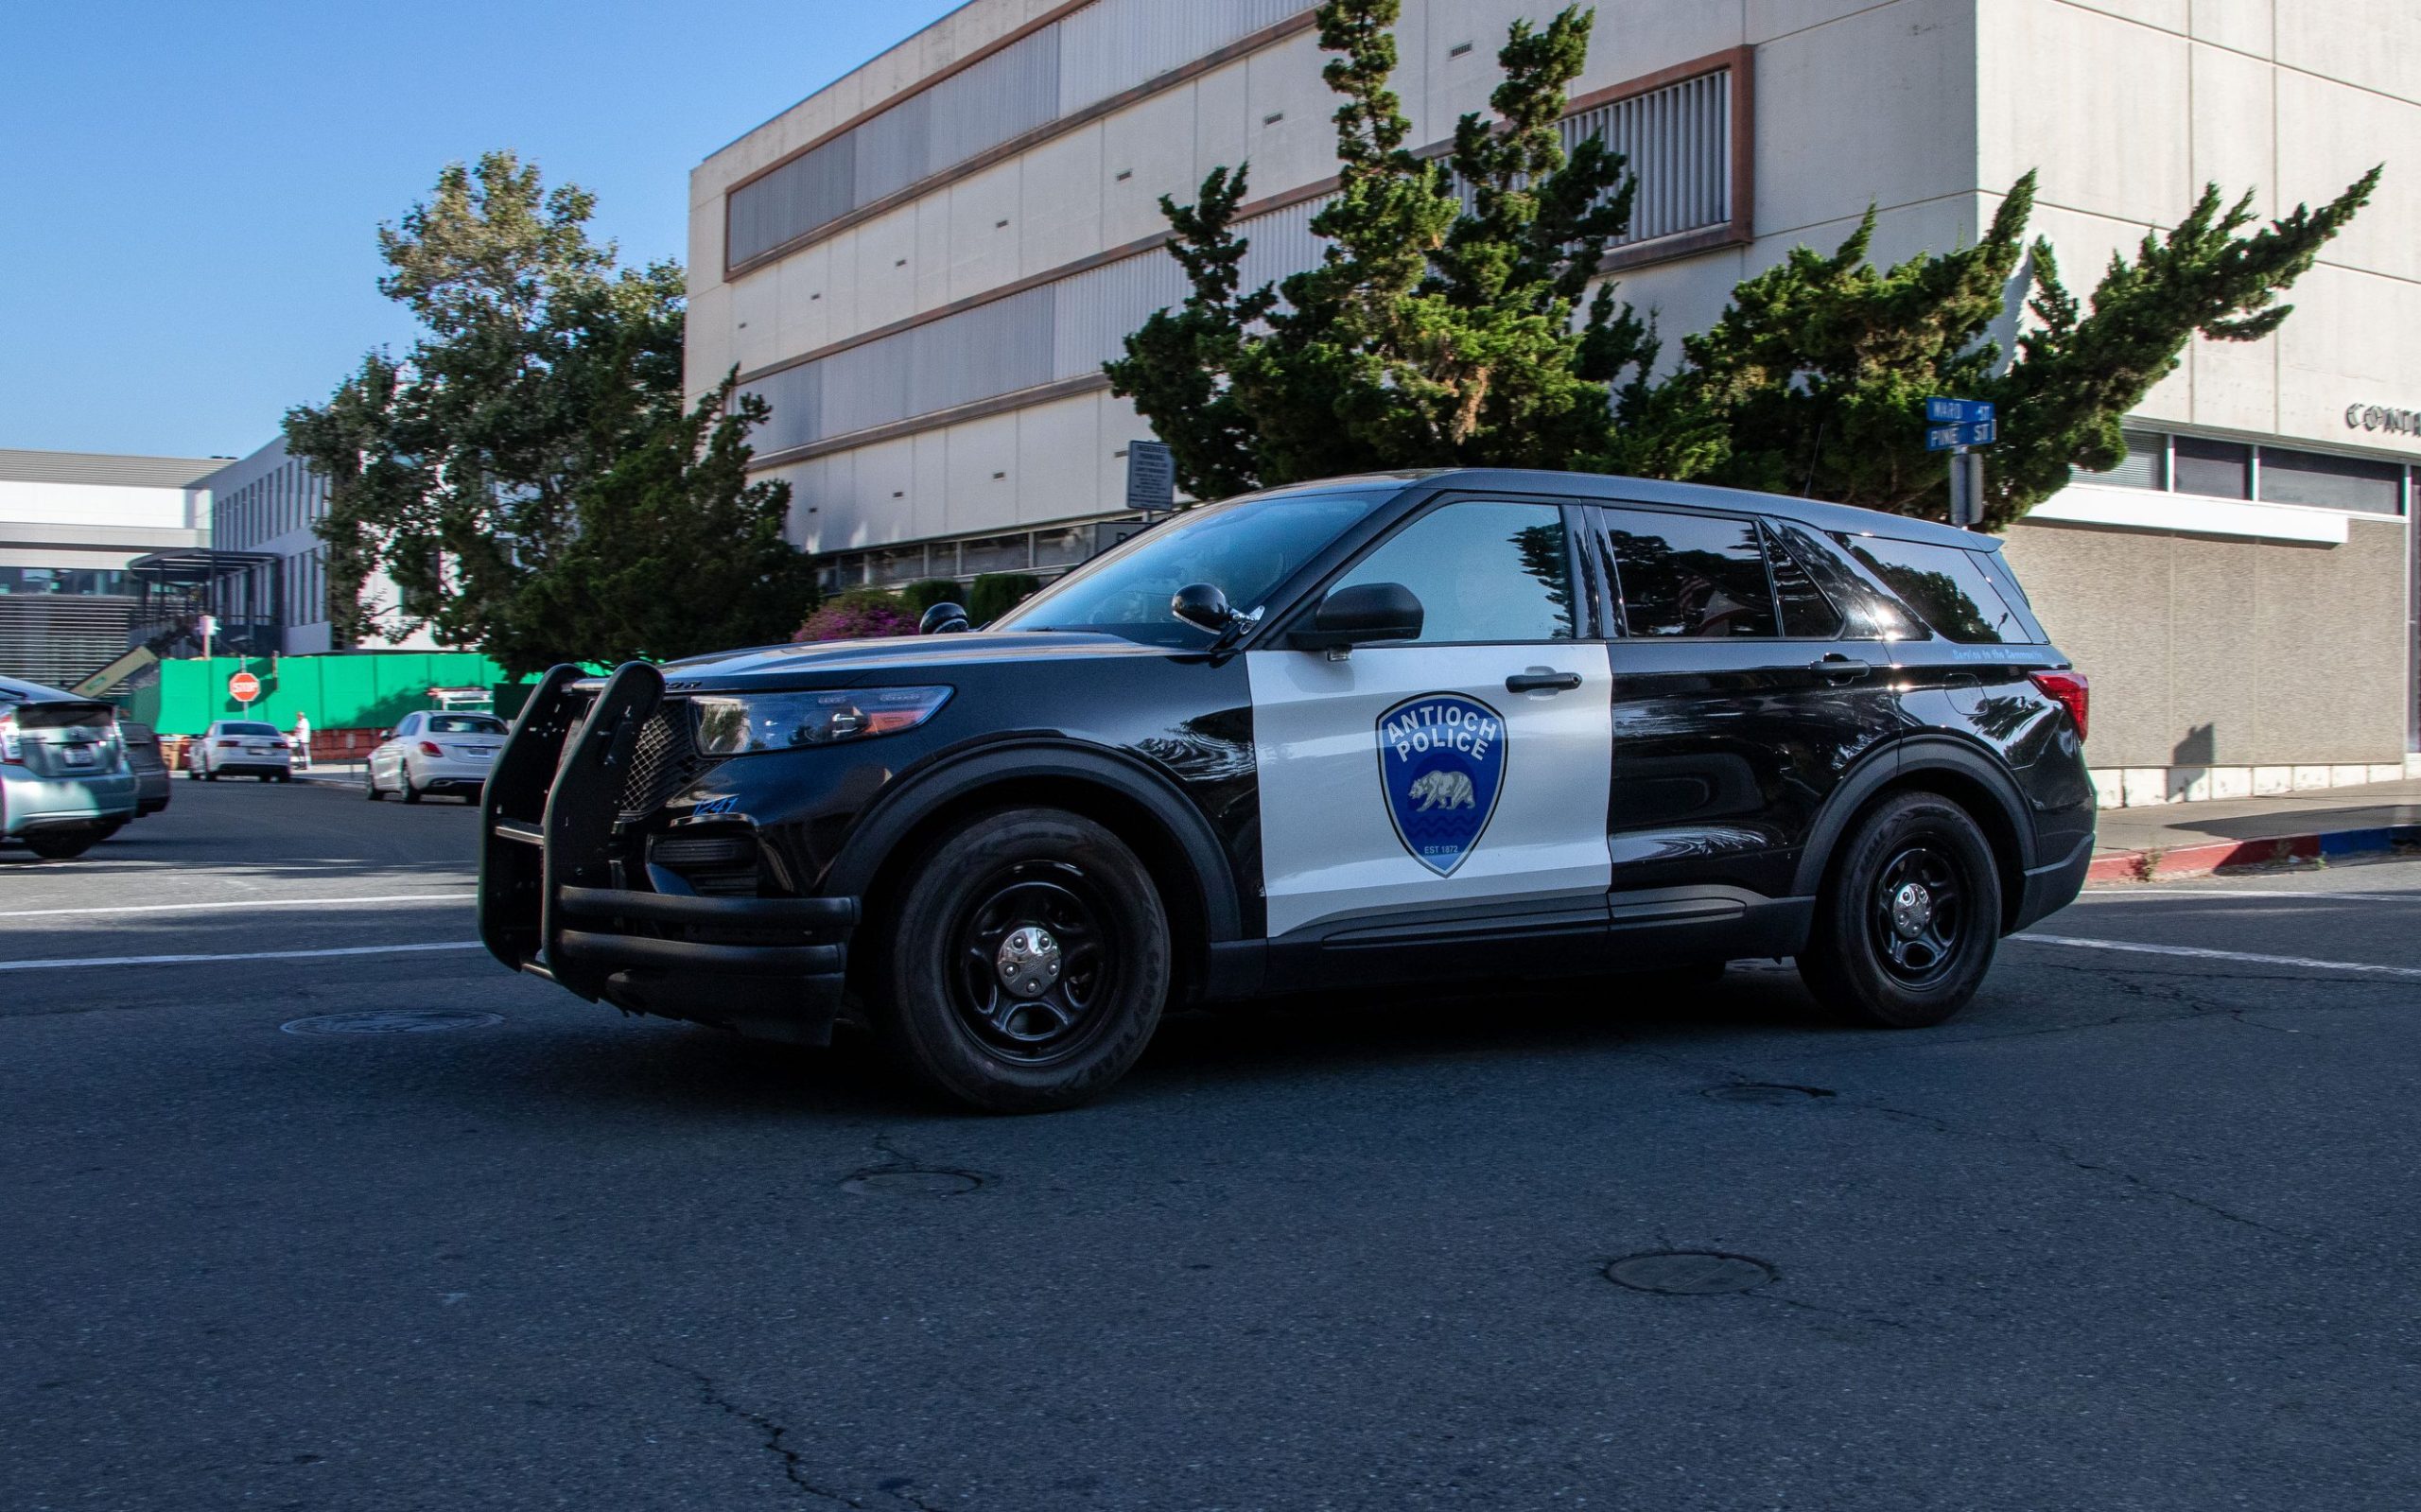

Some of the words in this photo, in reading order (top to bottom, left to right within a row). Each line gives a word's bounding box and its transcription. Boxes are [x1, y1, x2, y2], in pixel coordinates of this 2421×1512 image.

[1933, 400, 1962, 420] WARD
[1975, 406, 1990, 421] ST
[1930, 426, 1959, 447] PINE
[1974, 424, 1990, 442] ST
[232, 682, 258, 693] STOP
[1387, 705, 1497, 744] ANTIOCH
[1396, 727, 1489, 763] POLICE
[1424, 845, 1439, 854] EST
[1441, 844, 1458, 853] 1872
